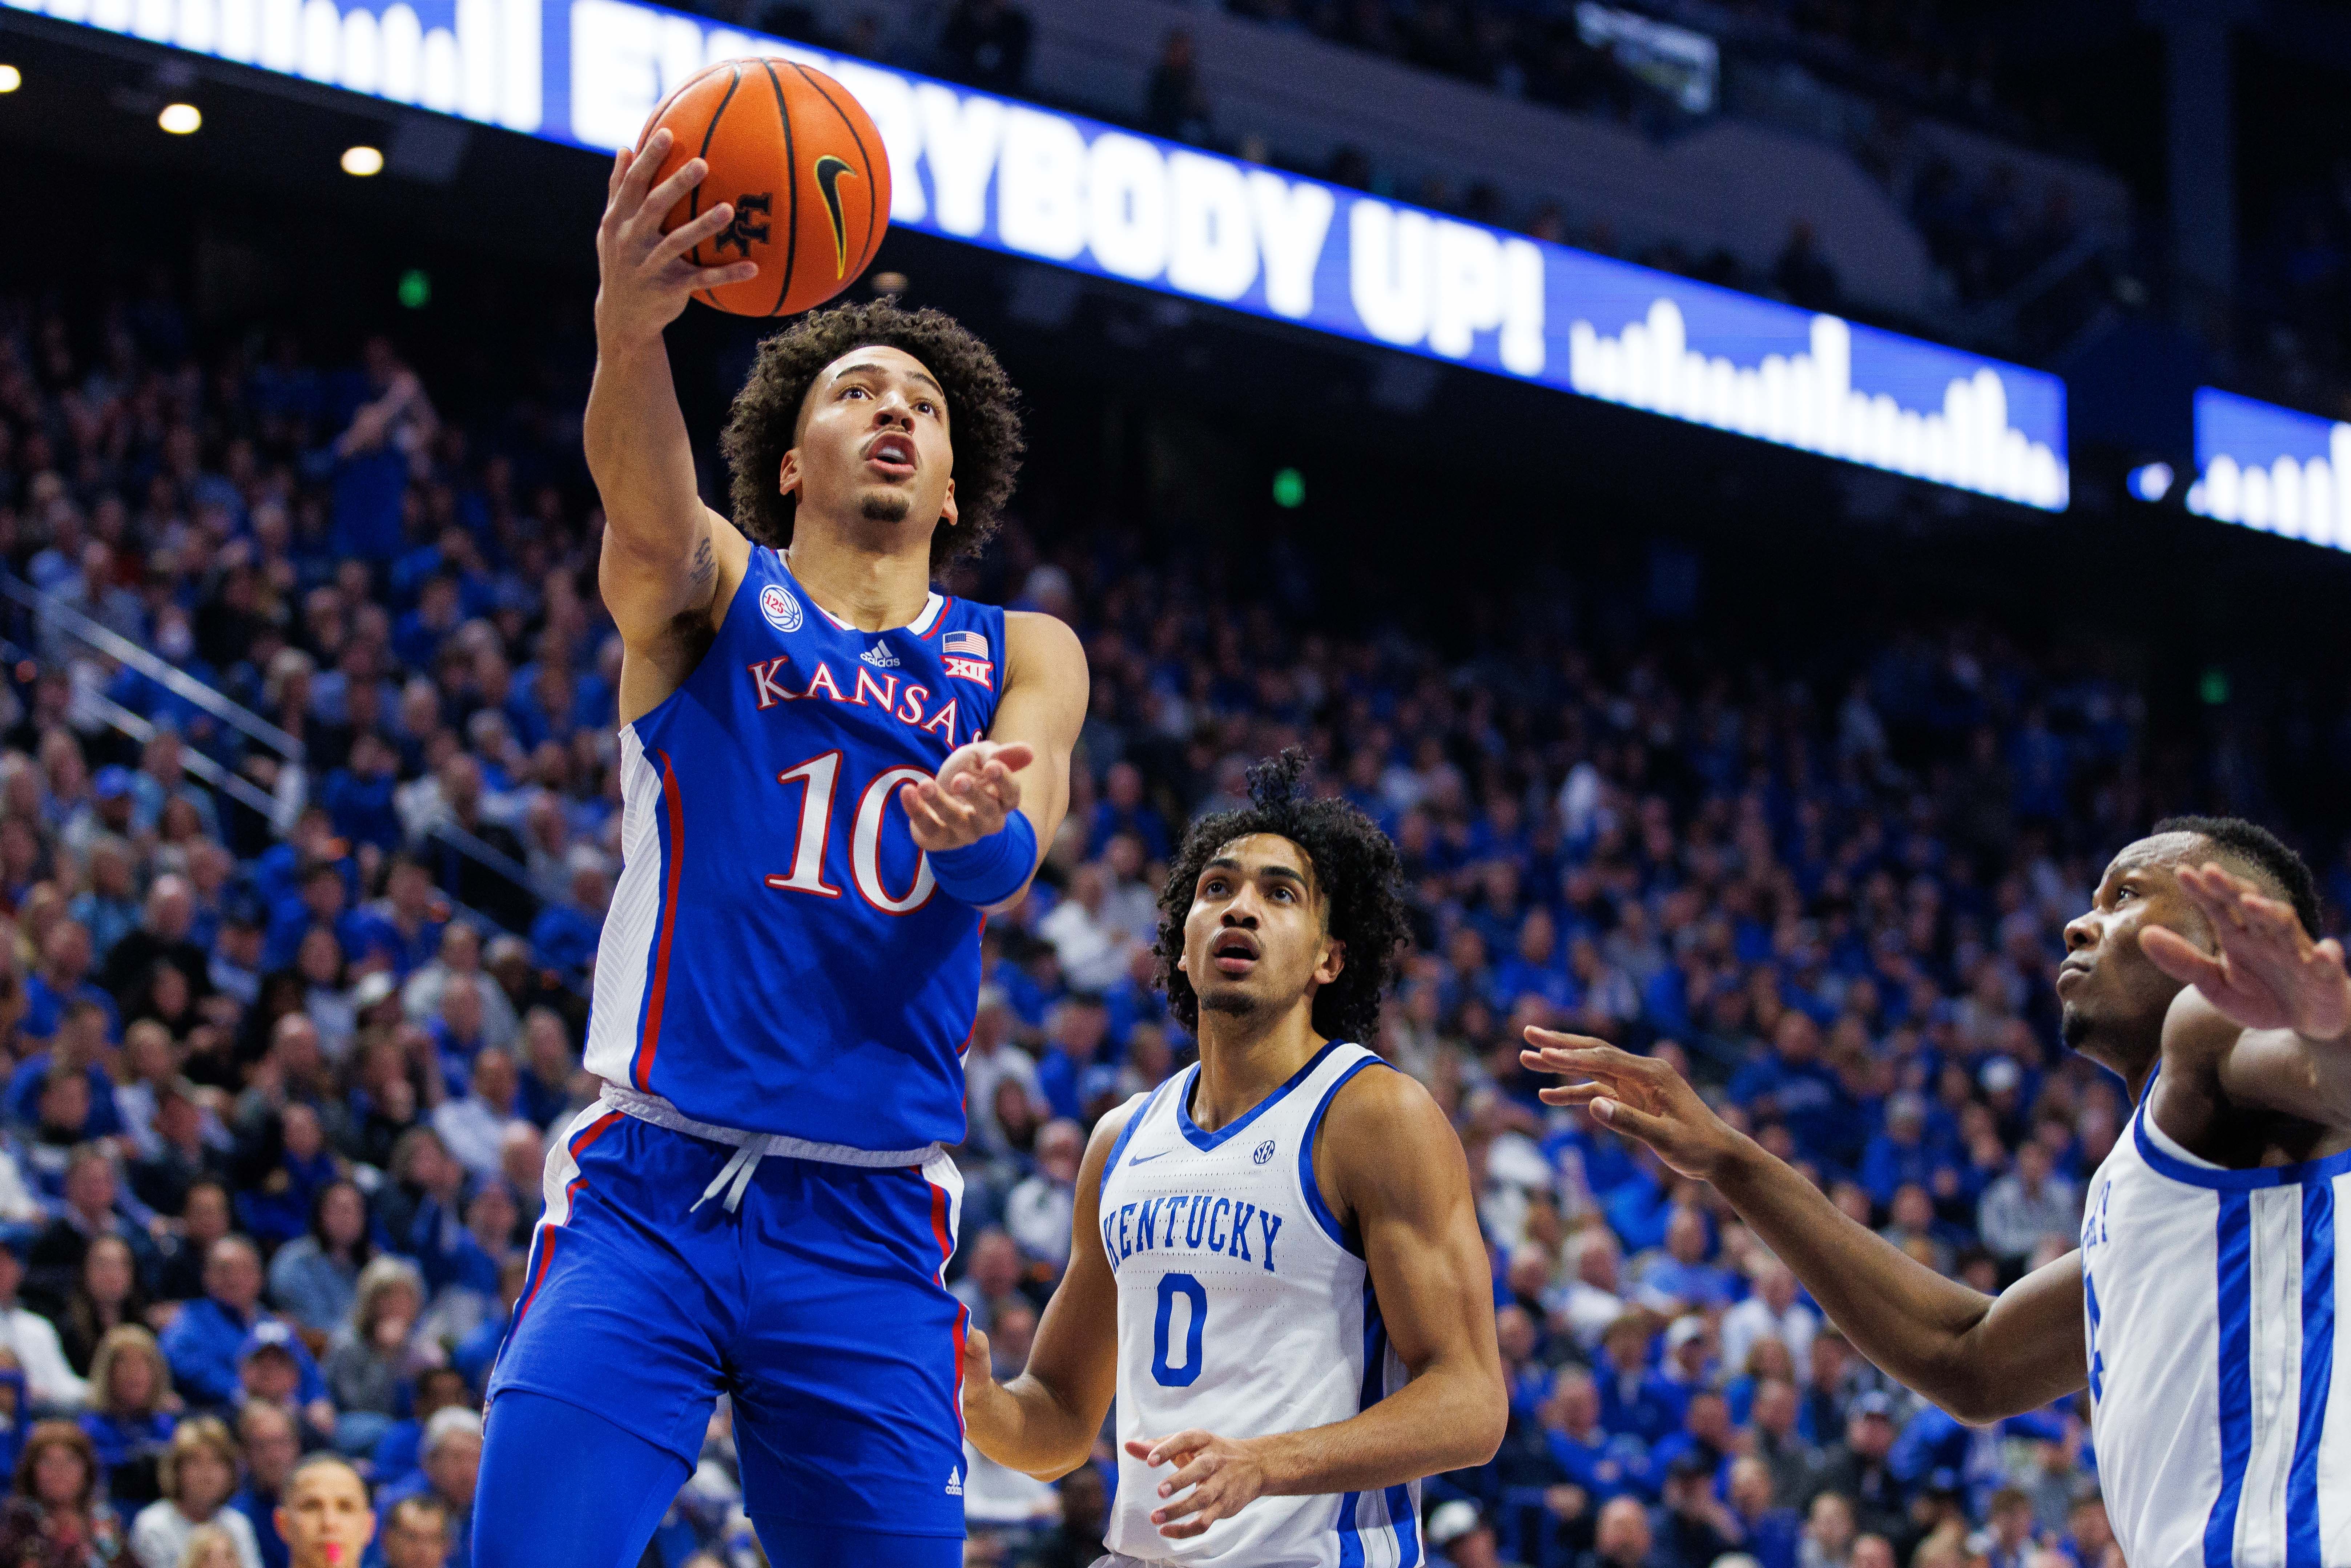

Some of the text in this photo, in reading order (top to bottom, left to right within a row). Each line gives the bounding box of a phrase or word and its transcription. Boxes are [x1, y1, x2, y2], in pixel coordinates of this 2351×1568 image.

[574, 1, 1545, 376] ERYBODY UP!
[765, 593, 784, 614] 125
[860, 652, 901, 668] adidas
[940, 655, 994, 692] XII
[747, 656, 983, 749] KANSA
[764, 748, 938, 916] 10
[1254, 1140, 1275, 1164] SEC
[1103, 1195, 1282, 1274] KENTUCKY
[1151, 1272, 1207, 1387] 0
